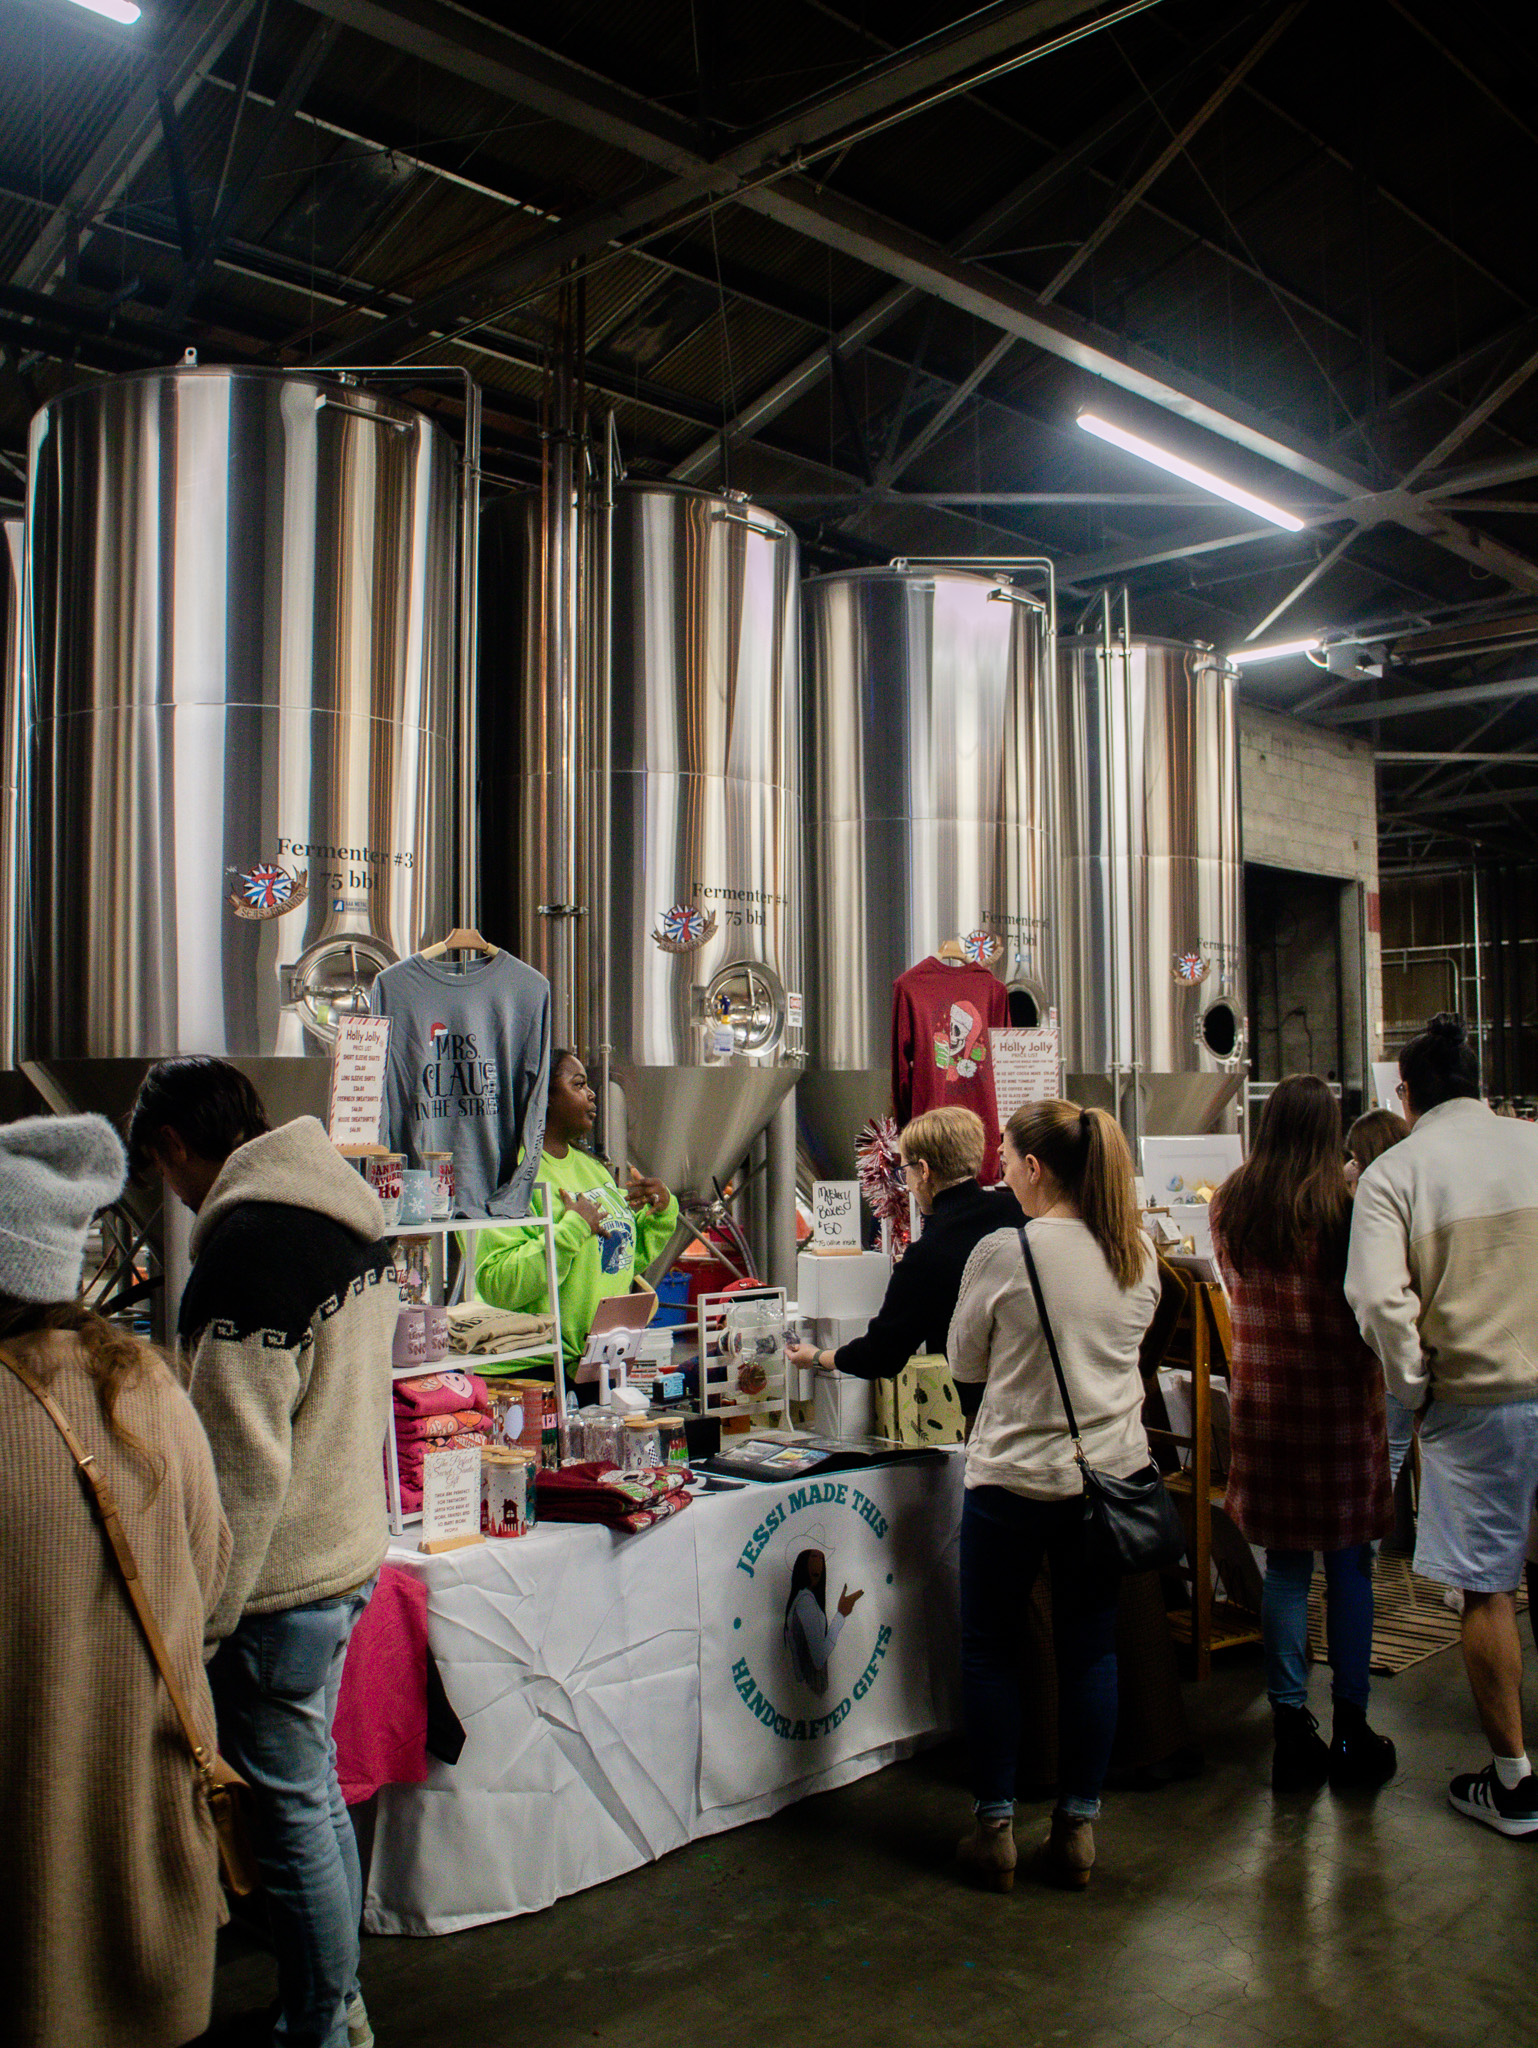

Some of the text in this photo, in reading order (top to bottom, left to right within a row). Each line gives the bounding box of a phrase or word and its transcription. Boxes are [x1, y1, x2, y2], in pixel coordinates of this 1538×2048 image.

[277, 838, 414, 869] Fermenter #3
[320, 870, 379, 890] 75 bbl
[692, 882, 773, 904] Fermenter
[725, 909, 766, 926] 75 bbl
[346, 1029, 381, 1045] Holly Jolly
[436, 1033, 481, 1061] MRS.
[1000, 1041, 1053, 1055] Holly Jolly
[415, 1101, 431, 1121] IN
[818, 1186, 851, 1210] Mystery
[816, 1204, 846, 1219] Boxes
[736, 1482, 889, 1579] JESSI MADE THIS
[731, 1624, 893, 1741] HANDCRAFTED GIFTS
